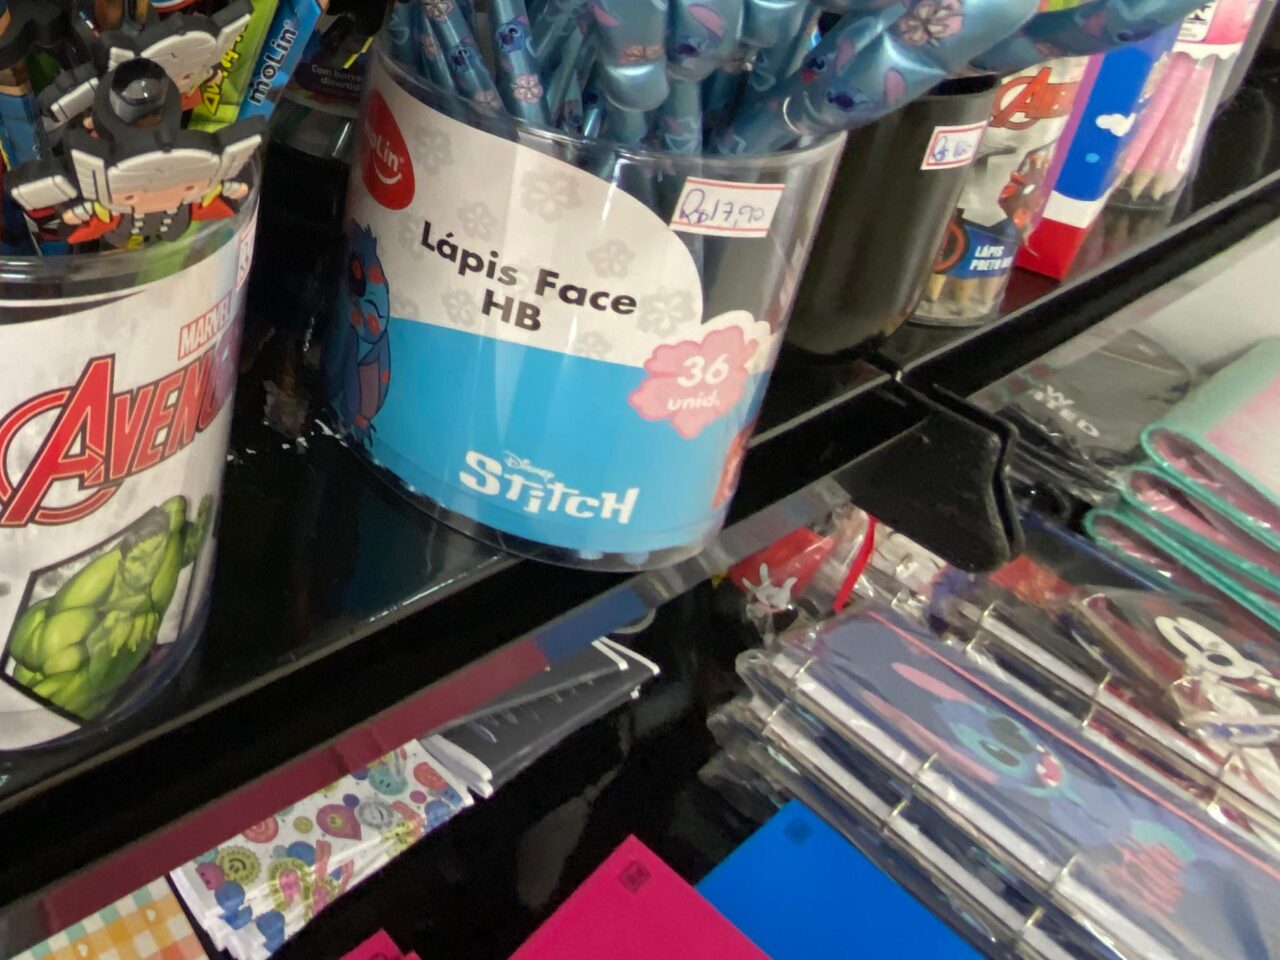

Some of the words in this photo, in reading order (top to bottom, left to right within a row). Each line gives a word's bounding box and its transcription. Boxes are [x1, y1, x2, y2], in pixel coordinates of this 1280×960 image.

[421, 220, 518, 286] Lápis
[534, 268, 638, 315] Face
[481, 288, 541, 332] HB
[677, 353, 730, 388] 36
[667, 390, 721, 411] unid.
